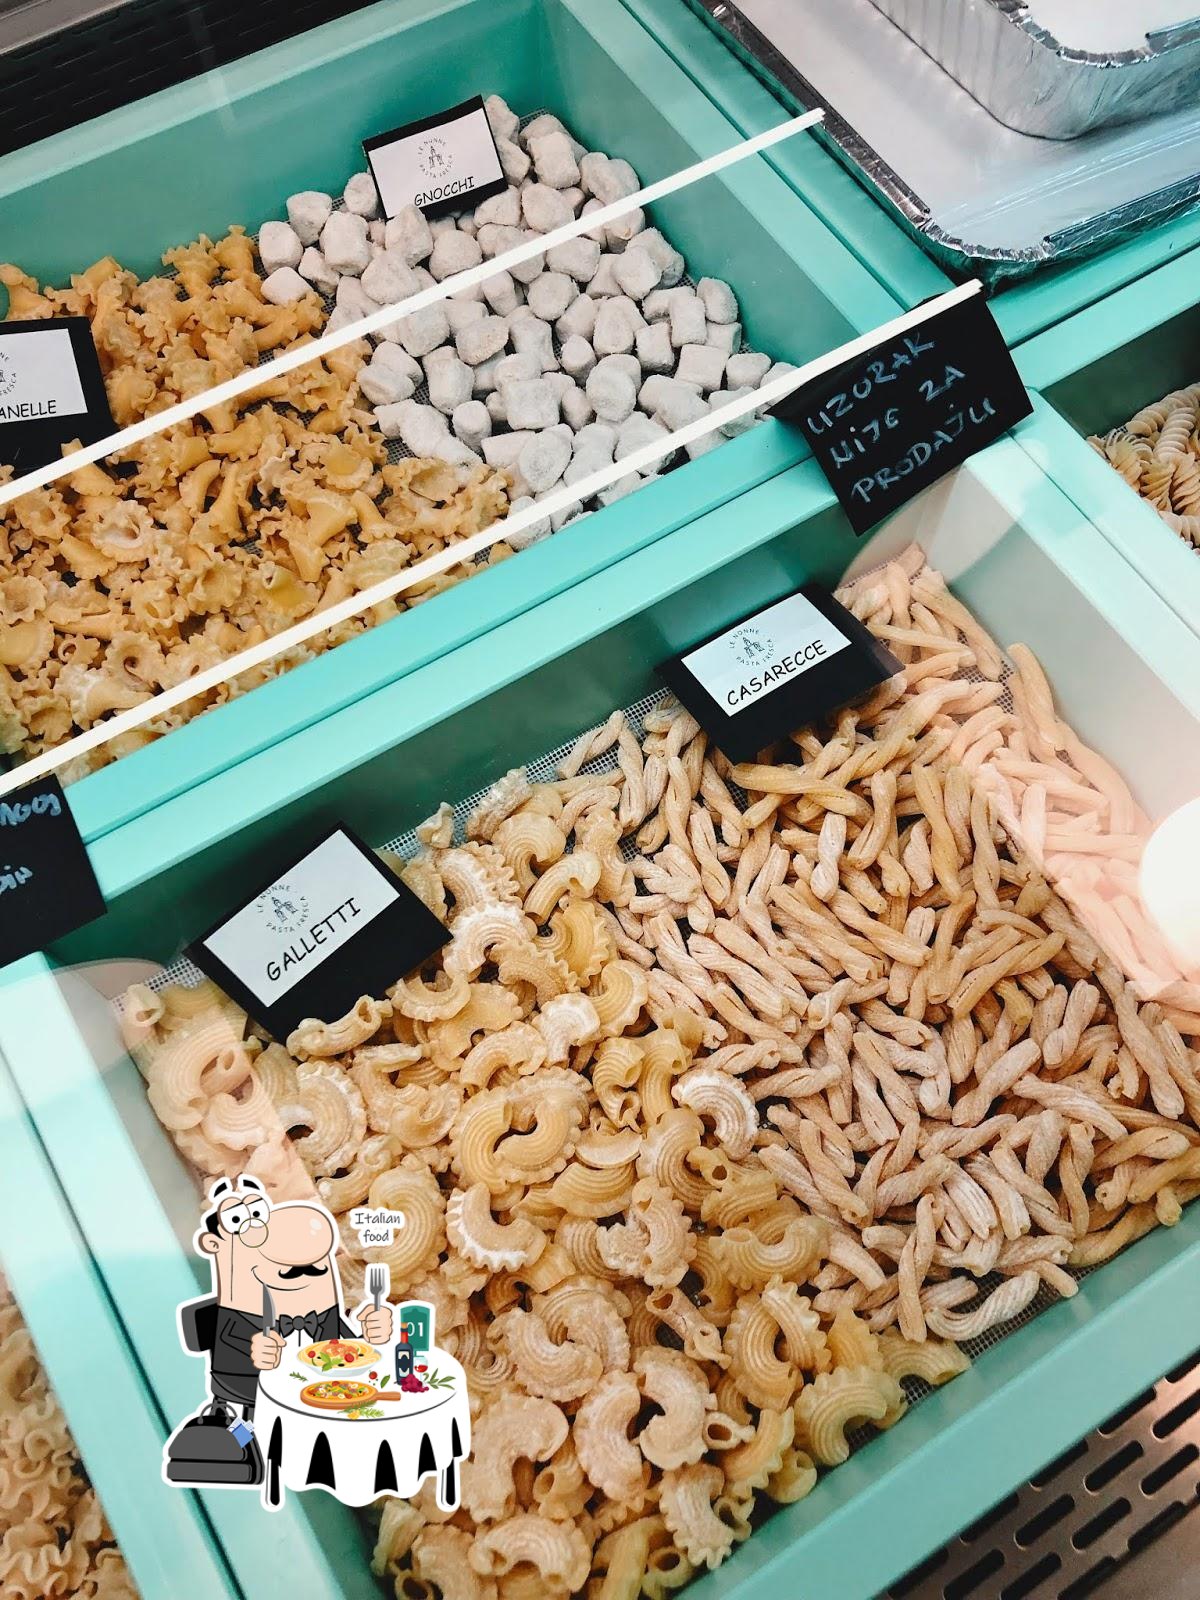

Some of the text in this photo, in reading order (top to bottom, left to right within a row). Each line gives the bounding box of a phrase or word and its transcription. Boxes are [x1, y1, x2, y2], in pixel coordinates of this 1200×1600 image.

[414, 176, 475, 207] GNOCCHI
[807, 332, 936, 435] UZORAK
[918, 364, 967, 402] ZA
[851, 397, 996, 503] PRODAJU
[733, 627, 760, 640] NONNE
[736, 638, 775, 667] PASTA FRESCA
[727, 639, 827, 706] CASARECCE
[259, 884, 291, 901] NONNE
[266, 922, 295, 933] PASTA
[266, 897, 361, 981] GALLETTI
